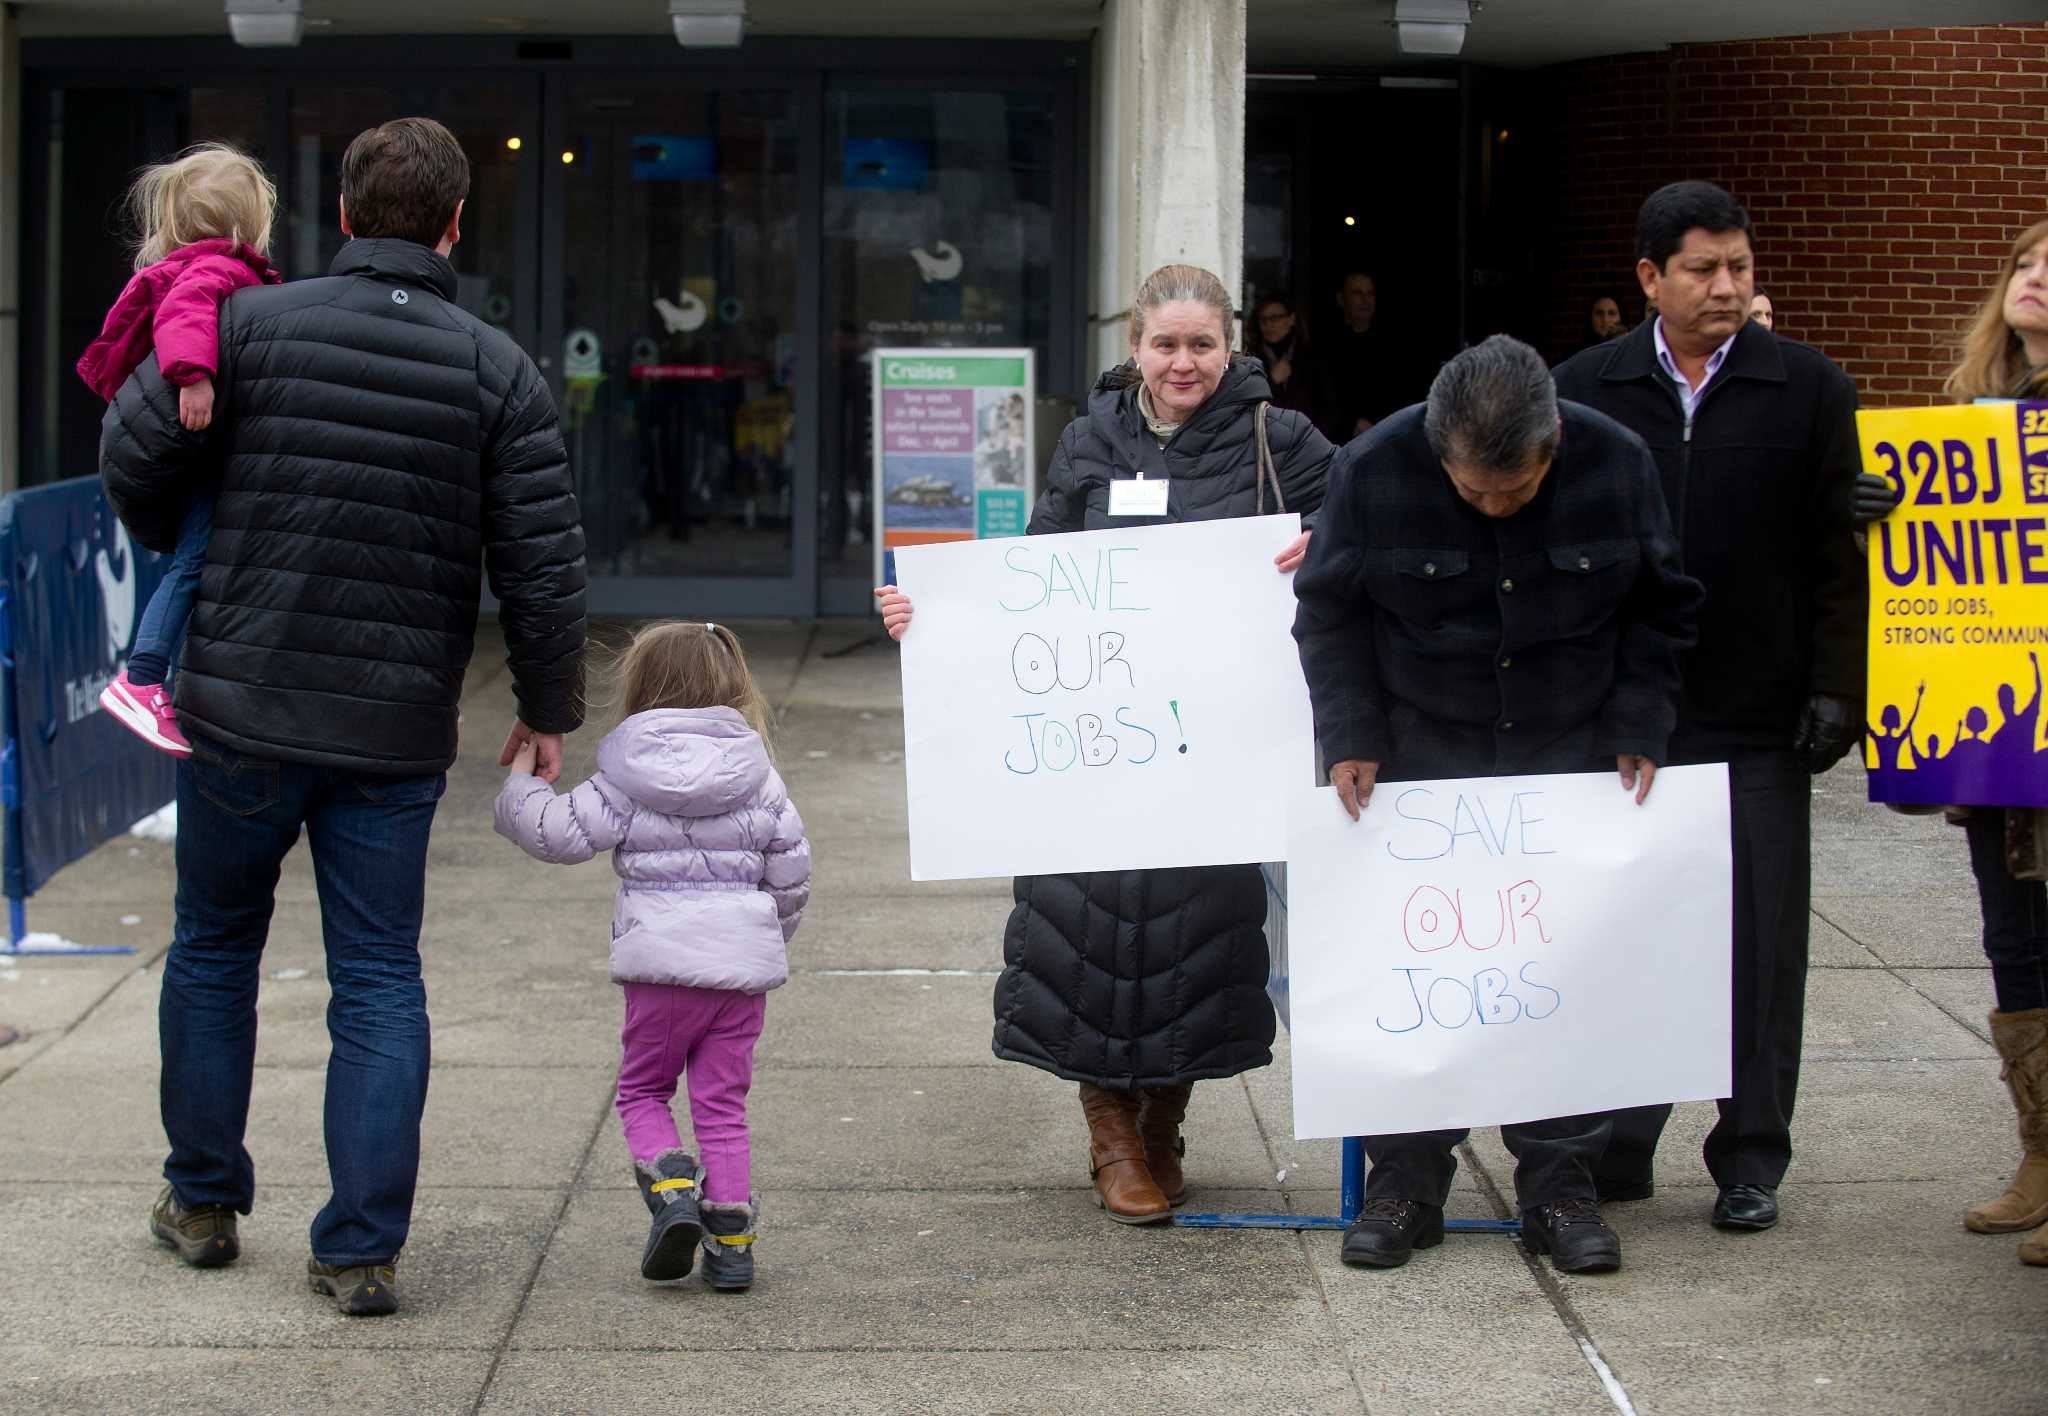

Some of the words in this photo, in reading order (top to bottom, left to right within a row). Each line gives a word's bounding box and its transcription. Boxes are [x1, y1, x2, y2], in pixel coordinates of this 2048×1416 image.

[887, 361, 957, 380] Cruises
[1874, 437, 2002, 506] 32BJ
[998, 546, 1151, 612] SAVE
[1880, 518, 2048, 587] UNITE
[1884, 598, 1938, 616] GOOD
[1944, 598, 1994, 618] JOBS,
[1884, 626, 1955, 645] STRONG
[1012, 631, 1135, 695] OUR
[1387, 788, 1558, 861] SAVE
[1403, 879, 1552, 952] OUR
[1377, 961, 1560, 1033] JOBS
